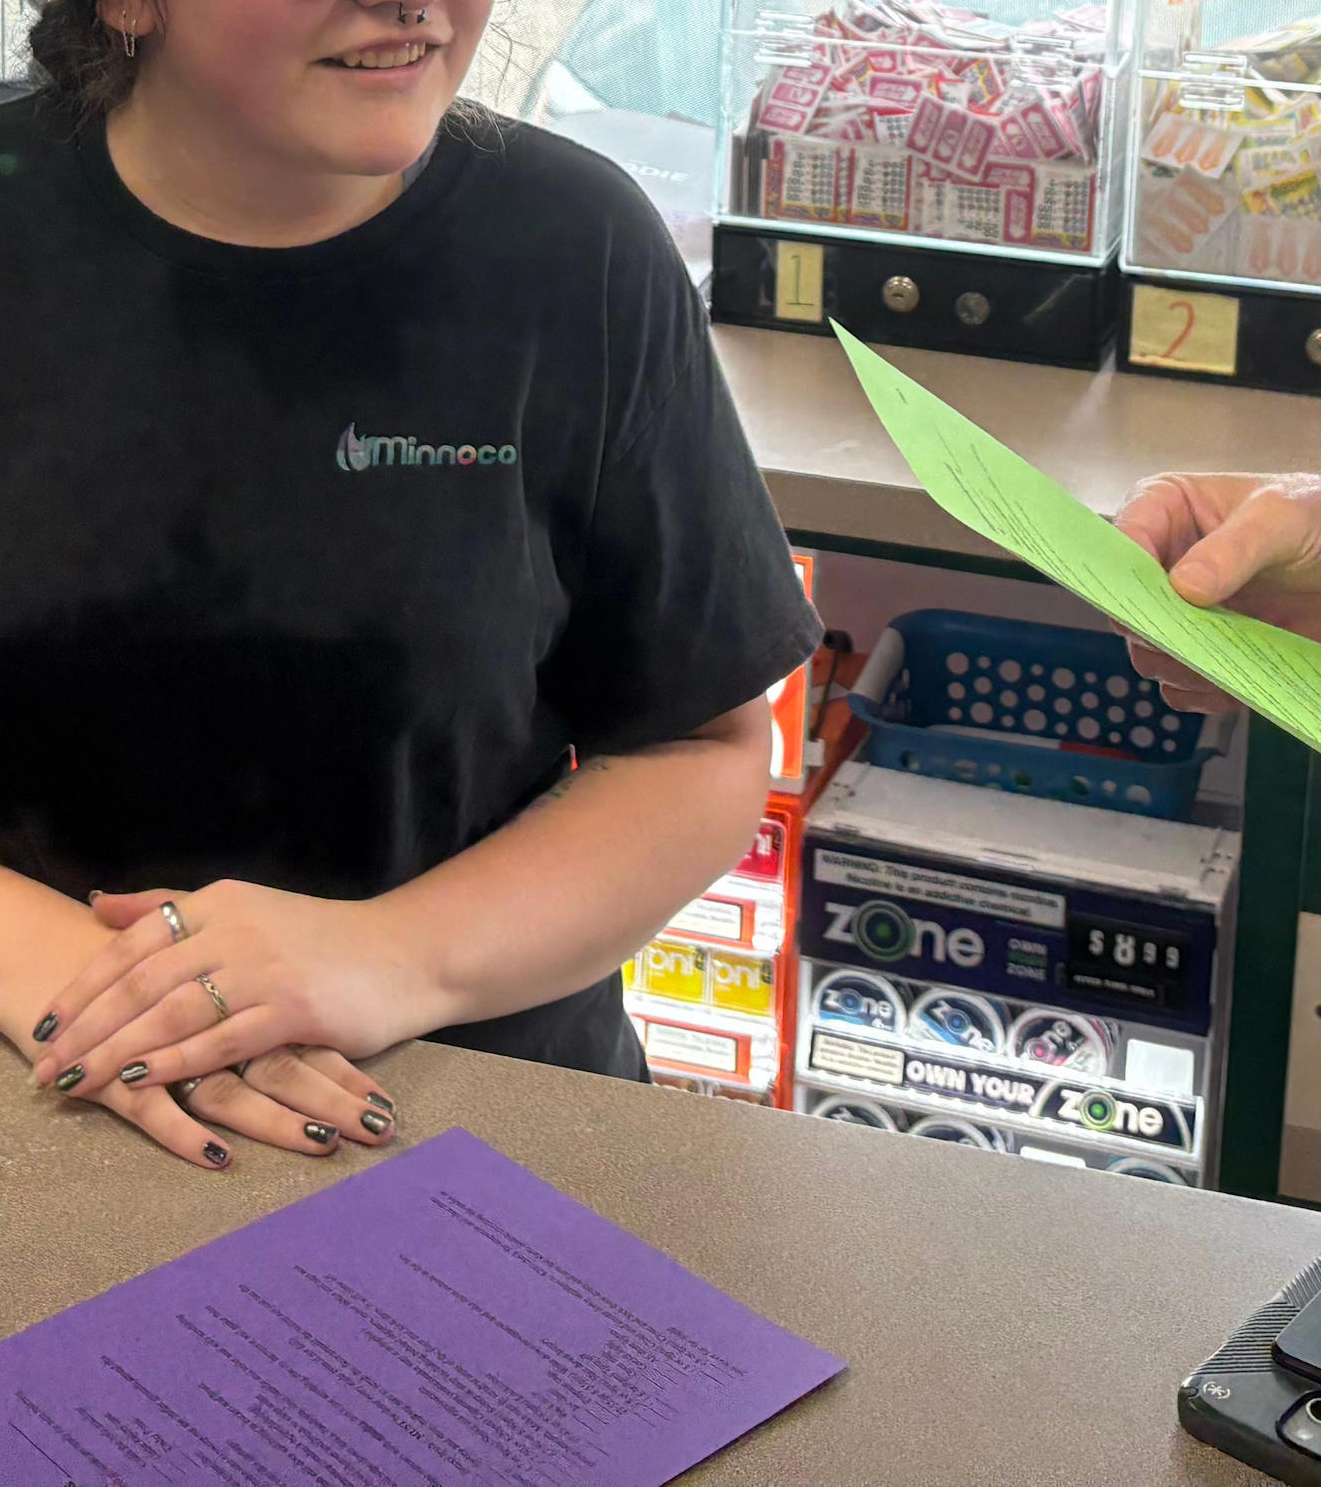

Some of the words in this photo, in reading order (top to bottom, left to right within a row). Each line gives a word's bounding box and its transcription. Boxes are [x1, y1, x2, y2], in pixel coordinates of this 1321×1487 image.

[1162, 299, 1196, 363] 2
[365, 436, 518, 466] Minnoco
[907, 1061, 966, 1090] OWN
[973, 1072, 1034, 1104] YOUR
